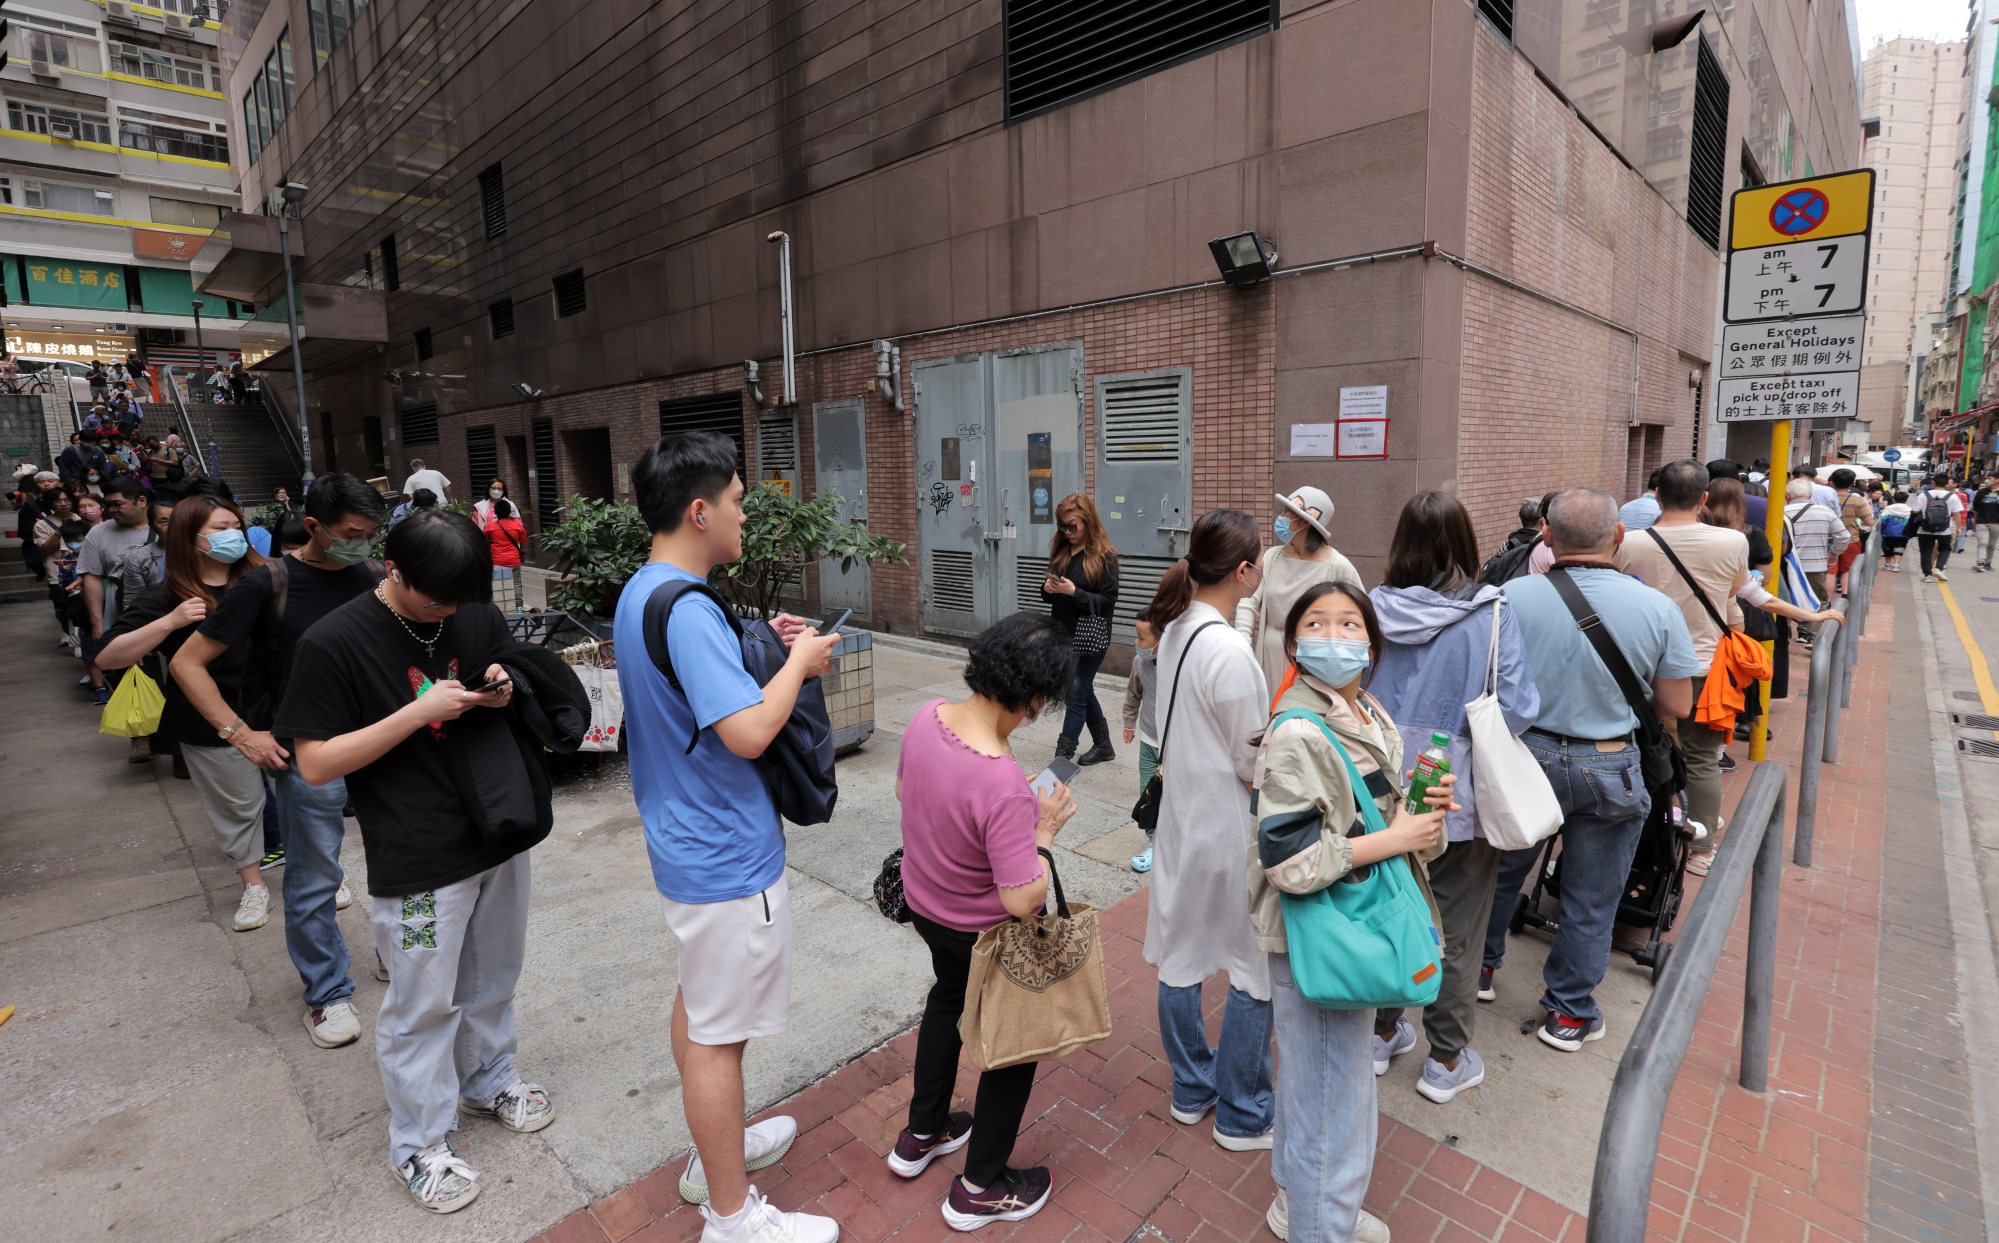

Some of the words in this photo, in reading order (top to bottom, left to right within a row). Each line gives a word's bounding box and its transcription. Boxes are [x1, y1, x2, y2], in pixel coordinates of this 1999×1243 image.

[1763, 250, 1786, 260] am
[1817, 244, 1839, 269] 7
[1755, 260, 1793, 276] 上午
[29, 265, 120, 288] 百佳酒店
[1760, 287, 1784, 299] pm
[1814, 284, 1836, 307] 7
[1753, 299, 1790, 313] 下午
[1767, 325, 1817, 338] Except
[1730, 340, 1785, 352] General
[1790, 336, 1855, 348] Holidays
[1730, 351, 1853, 369] 公眾假期例外
[1750, 379, 1796, 391] Except
[1799, 378, 1825, 388] taxi
[1733, 392, 1760, 404] pick
[1764, 390, 1817, 402] up/drop
[1821, 387, 1842, 398] off
[1725, 401, 1847, 418] 的士上落客除外
